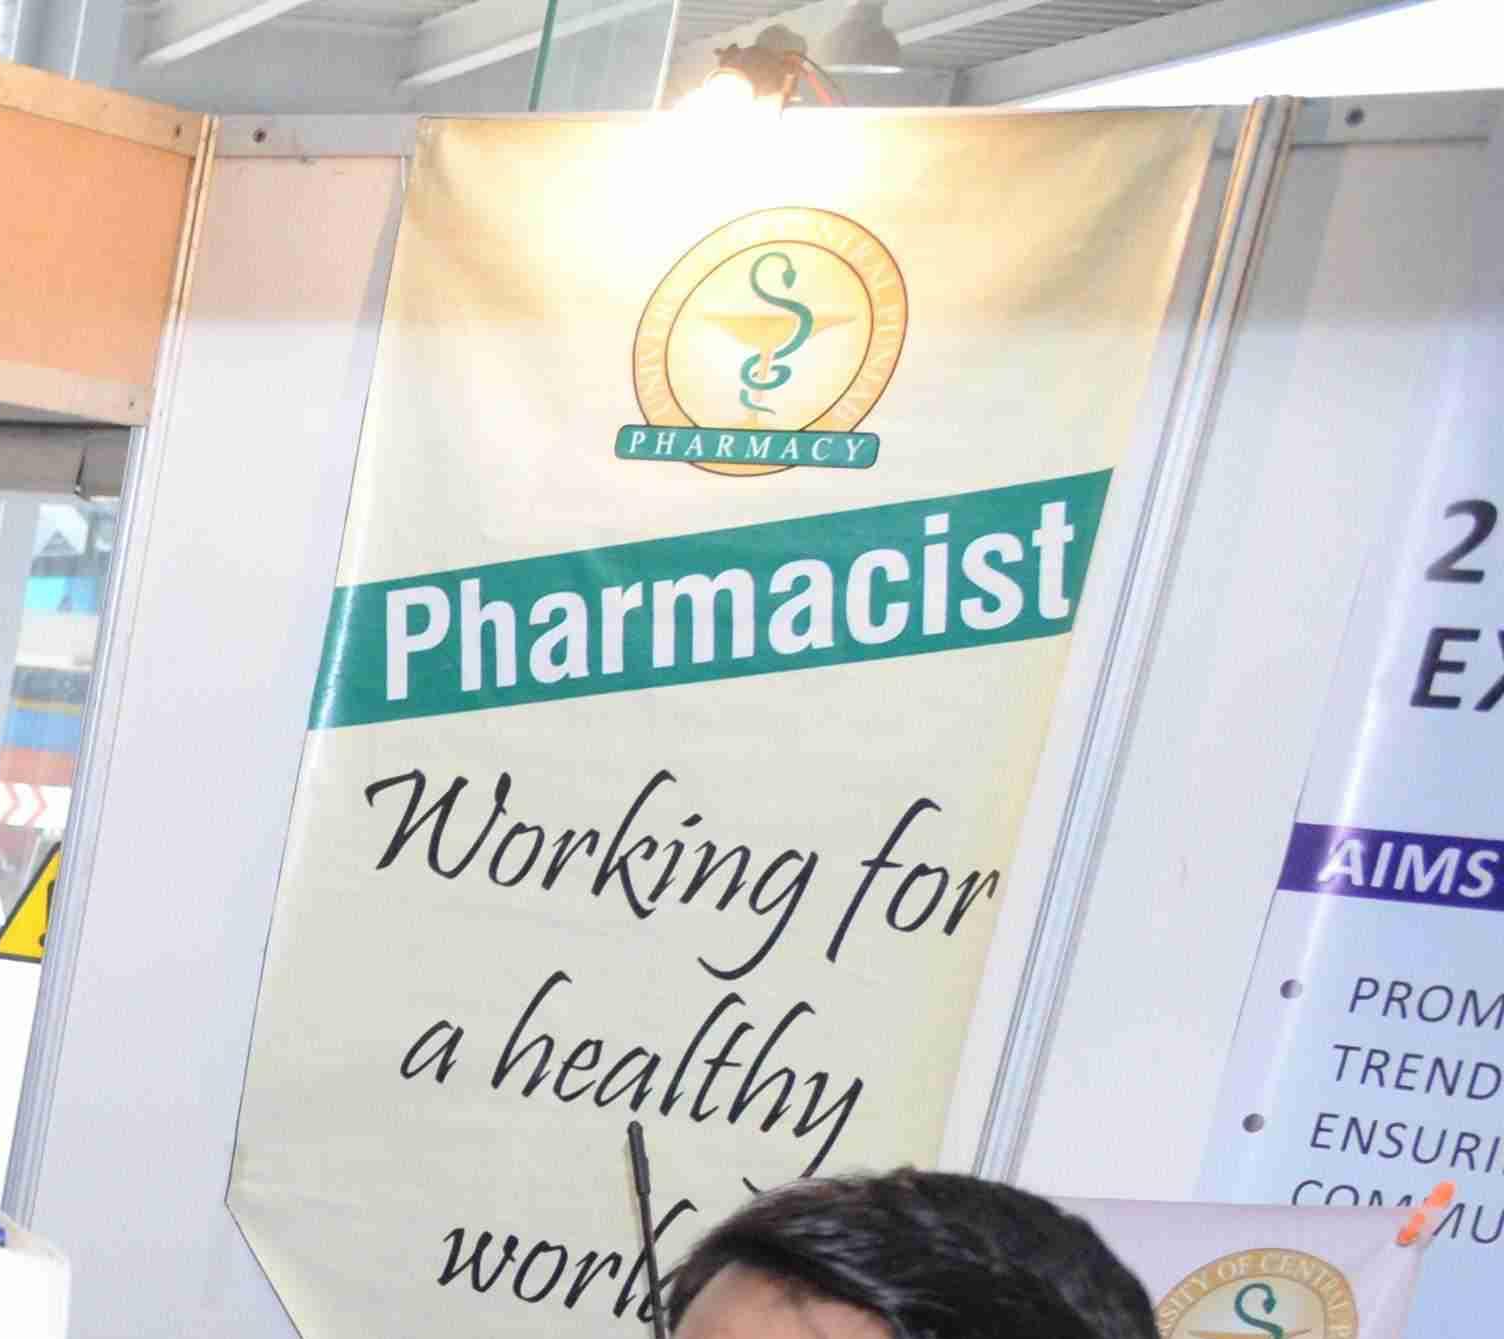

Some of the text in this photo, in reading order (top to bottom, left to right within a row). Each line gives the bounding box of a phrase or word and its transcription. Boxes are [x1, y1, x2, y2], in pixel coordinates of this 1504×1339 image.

[628, 431, 865, 462] PHARMACY
[384, 498, 1076, 701] Pharmacist
[364, 768, 1001, 981] Working for
[1317, 839, 1500, 899] AIMS
[1348, 976, 1504, 1031] PROM
[399, 970, 865, 1195] a healthy
[1332, 1043, 1503, 1101] TREND
[1309, 1112, 1504, 1174] ENSURI
